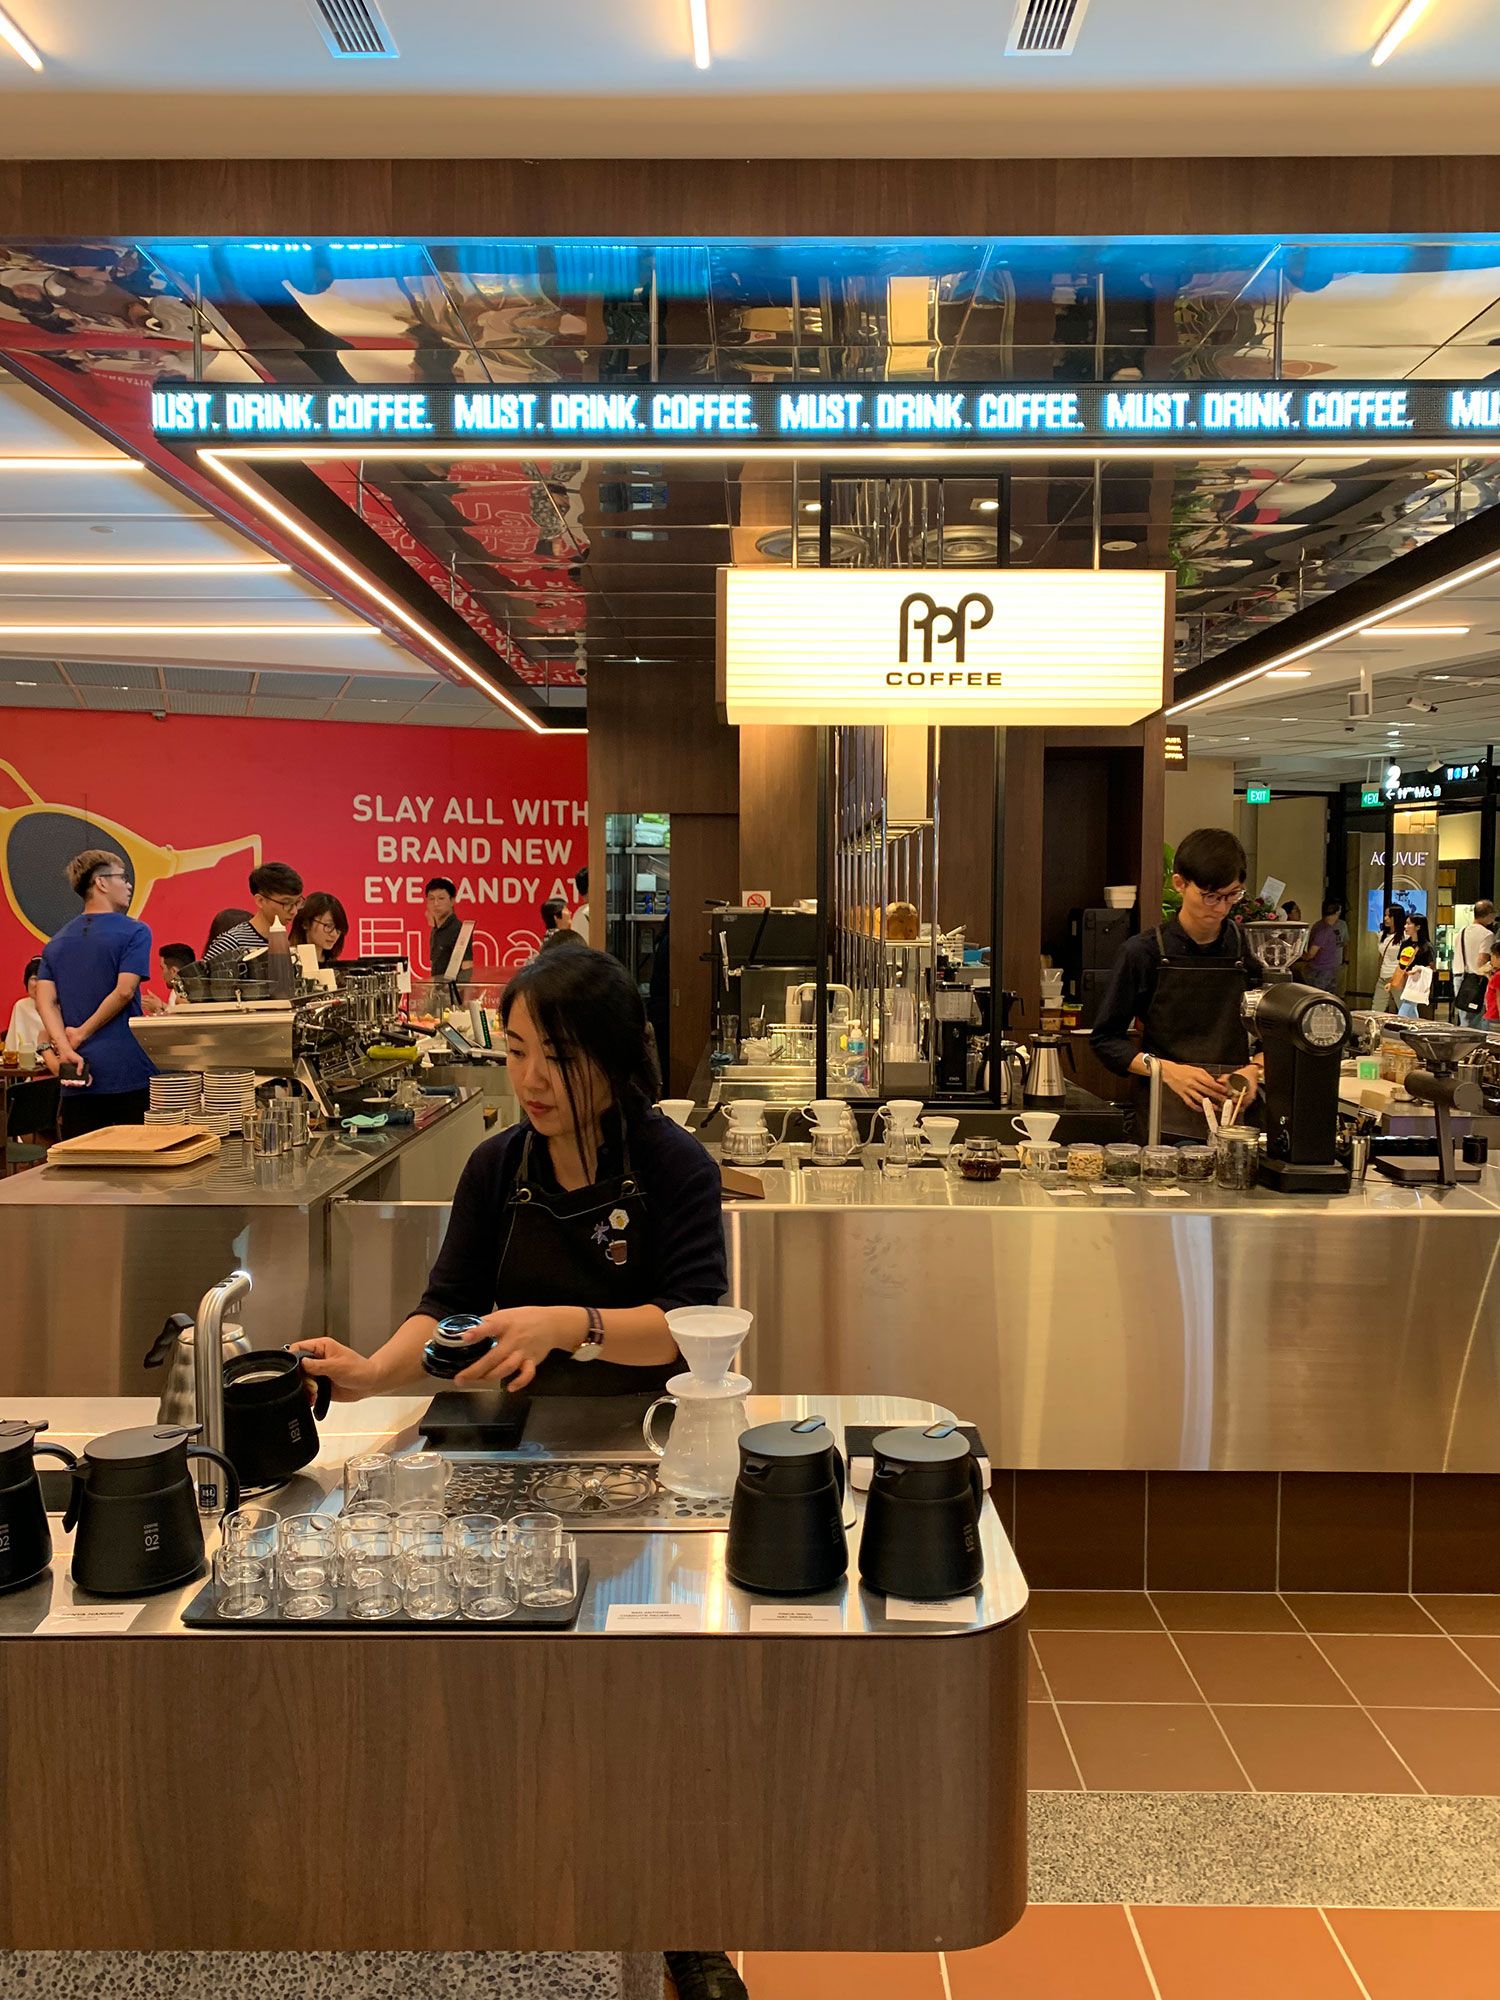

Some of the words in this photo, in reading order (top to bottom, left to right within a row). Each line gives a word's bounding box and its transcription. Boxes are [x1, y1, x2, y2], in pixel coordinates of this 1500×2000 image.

[152, 393, 220, 429] UST.
[225, 393, 322, 429] DRINK.
[327, 393, 433, 429] COFFEE.
[453, 393, 545, 429] MUST.
[550, 393, 646, 429] DRINK.
[652, 393, 759, 429] COFFEE.
[780, 393, 870, 428] MUST.
[876, 393, 972, 428] DRINK.
[978, 393, 1085, 428] COFFEE.
[1106, 392, 1197, 428] MUST.
[1204, 392, 1300, 428] DRINK.
[1307, 391, 1415, 427] COFFEE.
[886, 672, 1002, 686] COFFEE
[1385, 765, 1401, 789] 2
[1250, 790, 1267, 801] EXIT
[1367, 792, 1380, 804] EXI
[353, 795, 434, 823] SLAY
[443, 798, 504, 825] ALL
[512, 799, 588, 827] WITH
[377, 836, 491, 864] BRAND
[502, 839, 573, 865] NEW
[364, 876, 425, 904] EYE
[441, 877, 540, 904] ANDY
[144, 1534, 160, 1546] 02
